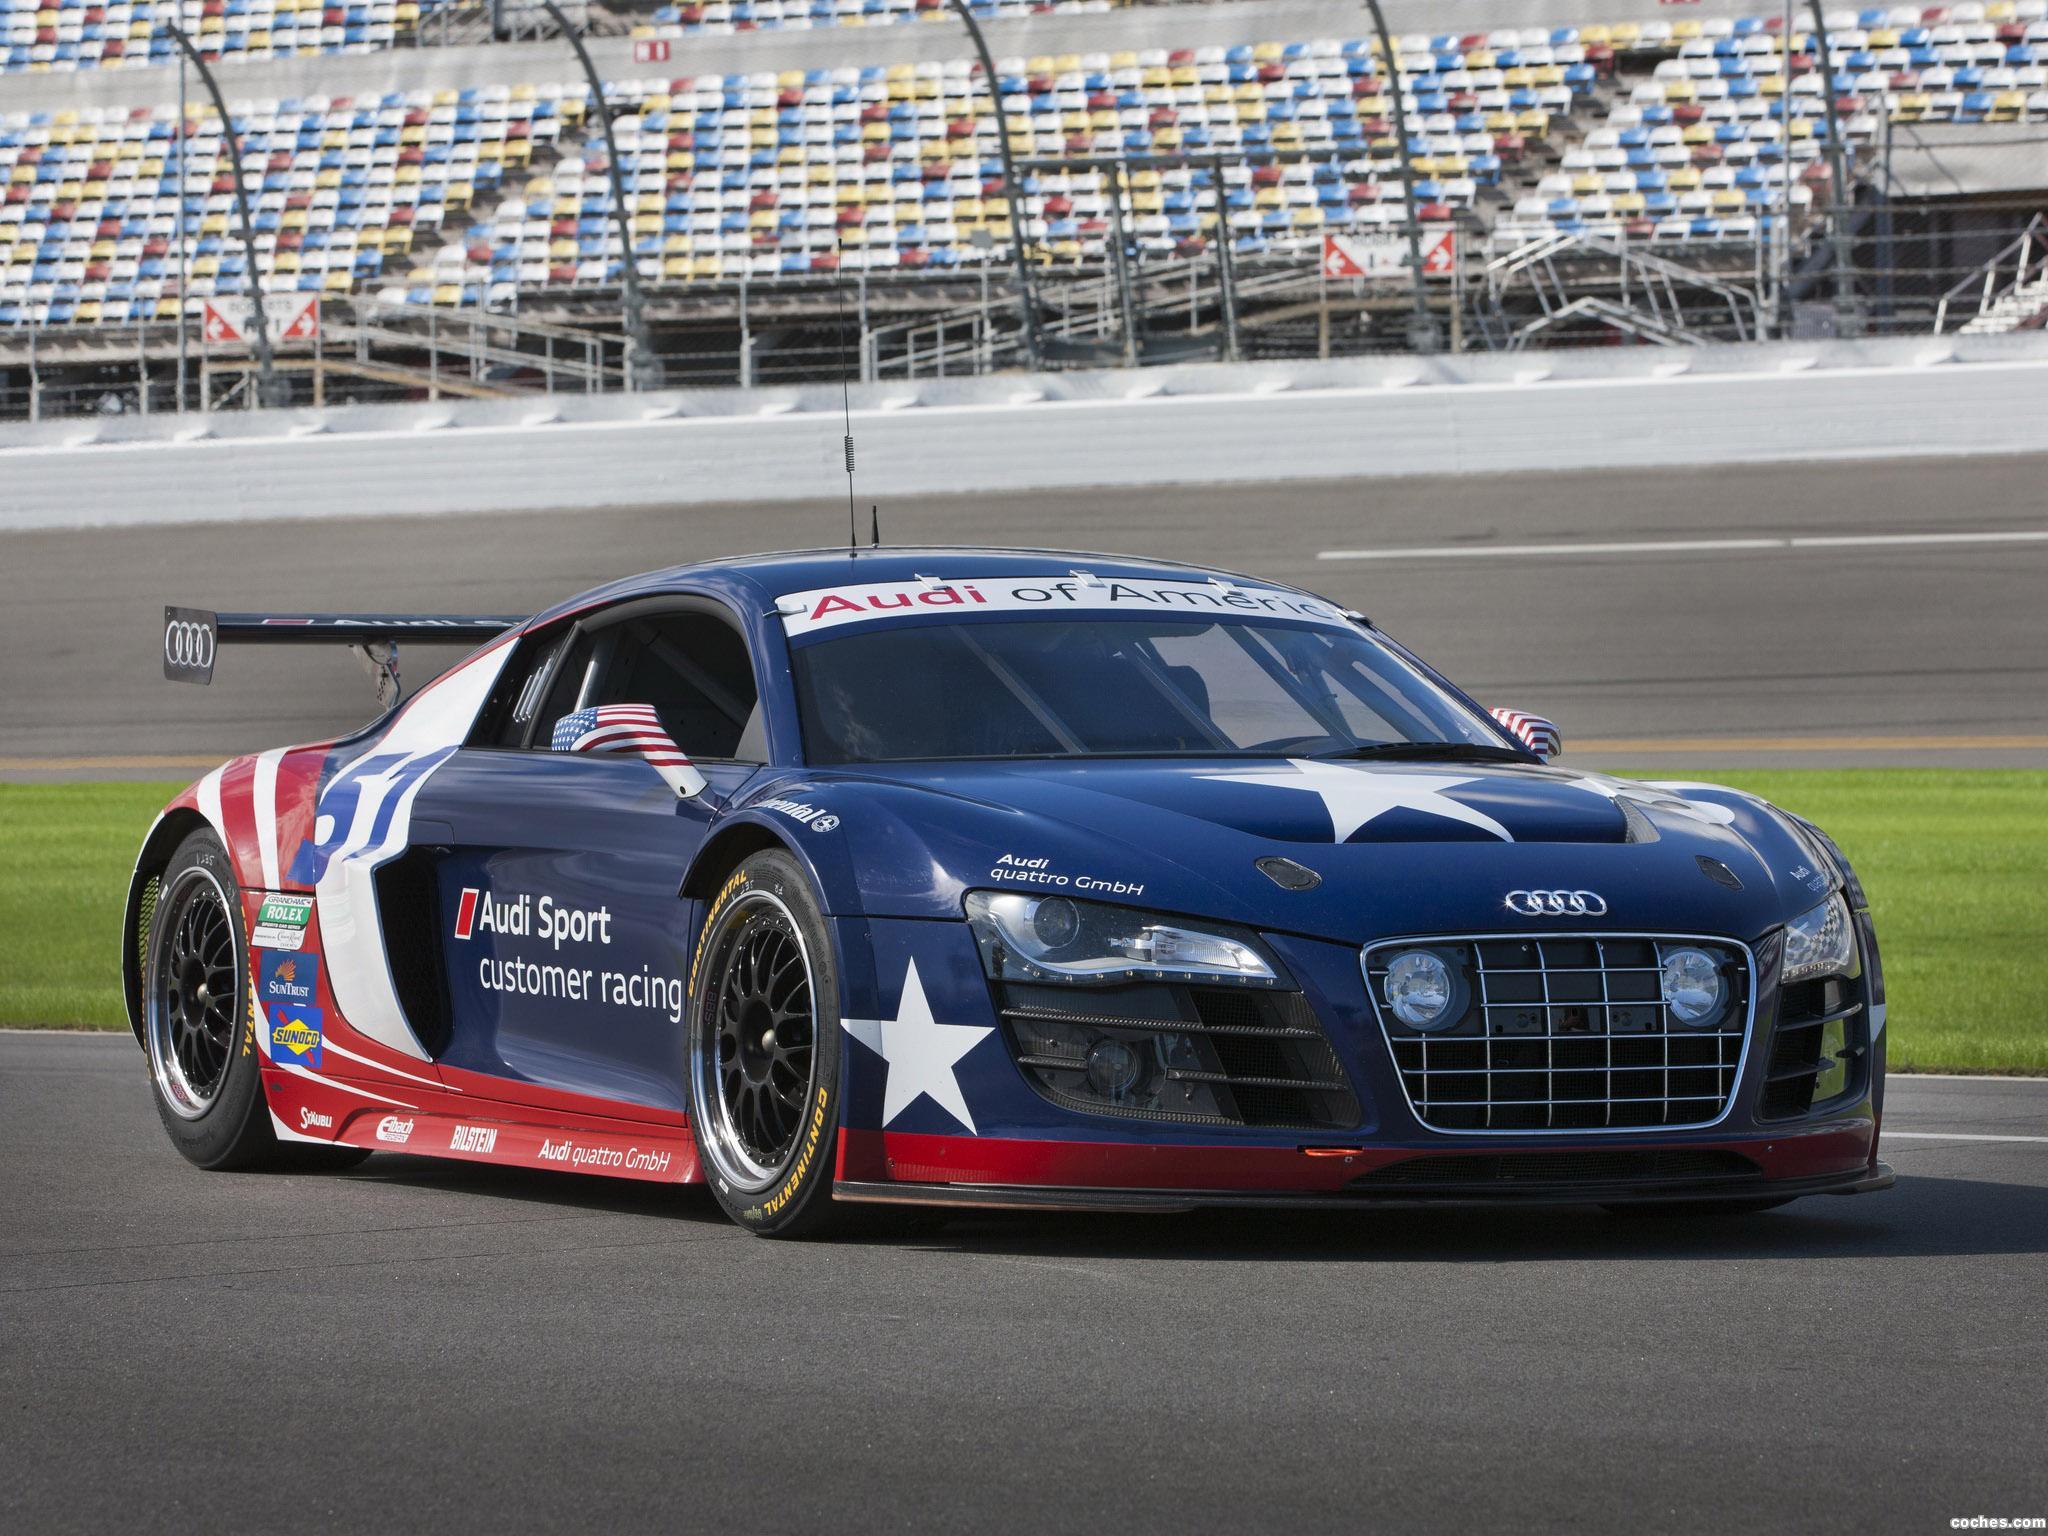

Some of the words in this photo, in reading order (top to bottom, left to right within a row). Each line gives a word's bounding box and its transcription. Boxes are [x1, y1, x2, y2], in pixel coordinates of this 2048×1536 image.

[810, 585, 987, 620] Audi
[1011, 583, 1077, 602] of
[996, 854, 1050, 869] Audi
[990, 868, 1069, 886] quattro
[1075, 876, 1144, 896] GmbH
[266, 905, 304, 922] ROLEX
[479, 891, 530, 936] Audi
[538, 895, 611, 950] Sport
[688, 869, 748, 997] CONTINENTAL
[480, 956, 592, 1000] customer
[601, 964, 682, 1023] racing
[275, 1028, 319, 1047] SUNOCO
[376, 1115, 414, 1141] Eibach
[450, 1125, 498, 1153] BILSTEIN
[538, 1138, 572, 1160] Audi
[572, 1146, 622, 1167] quattro
[625, 1148, 671, 1172] GmbH
[763, 1087, 828, 1216] CONTINENTAL
